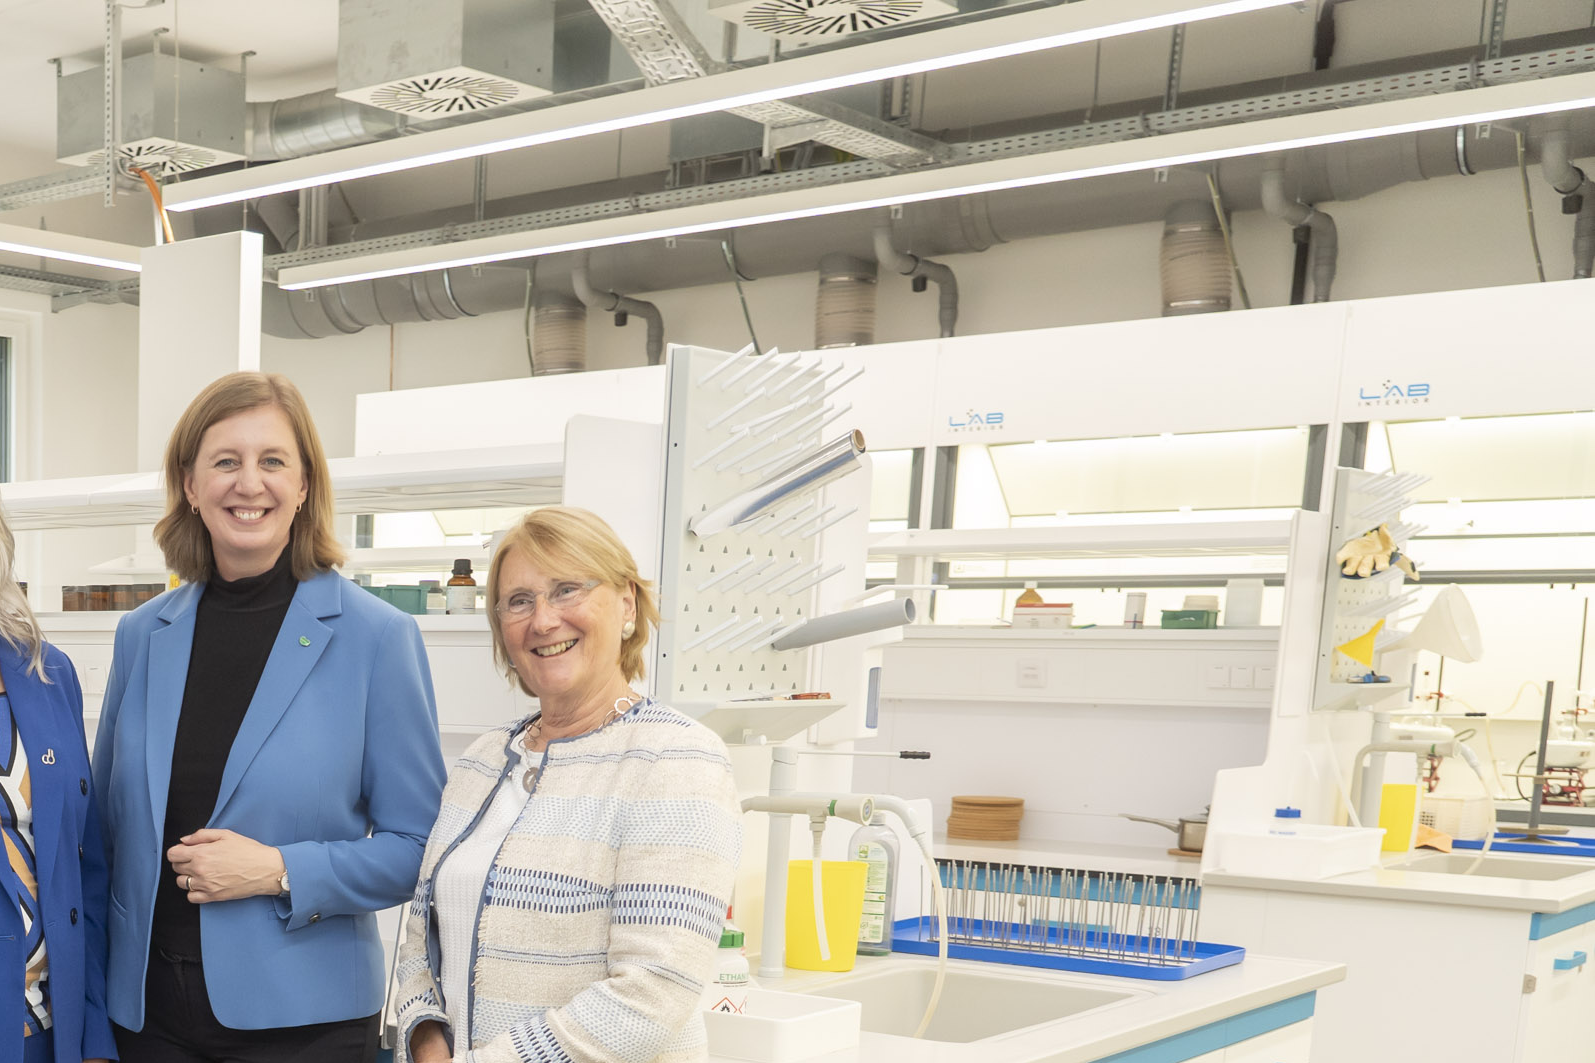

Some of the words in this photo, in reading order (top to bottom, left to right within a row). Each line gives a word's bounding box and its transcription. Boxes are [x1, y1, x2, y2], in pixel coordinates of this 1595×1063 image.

[1359, 384, 1430, 399] LAB
[1358, 398, 1429, 406] INTERIOR
[949, 412, 1004, 426] LAB
